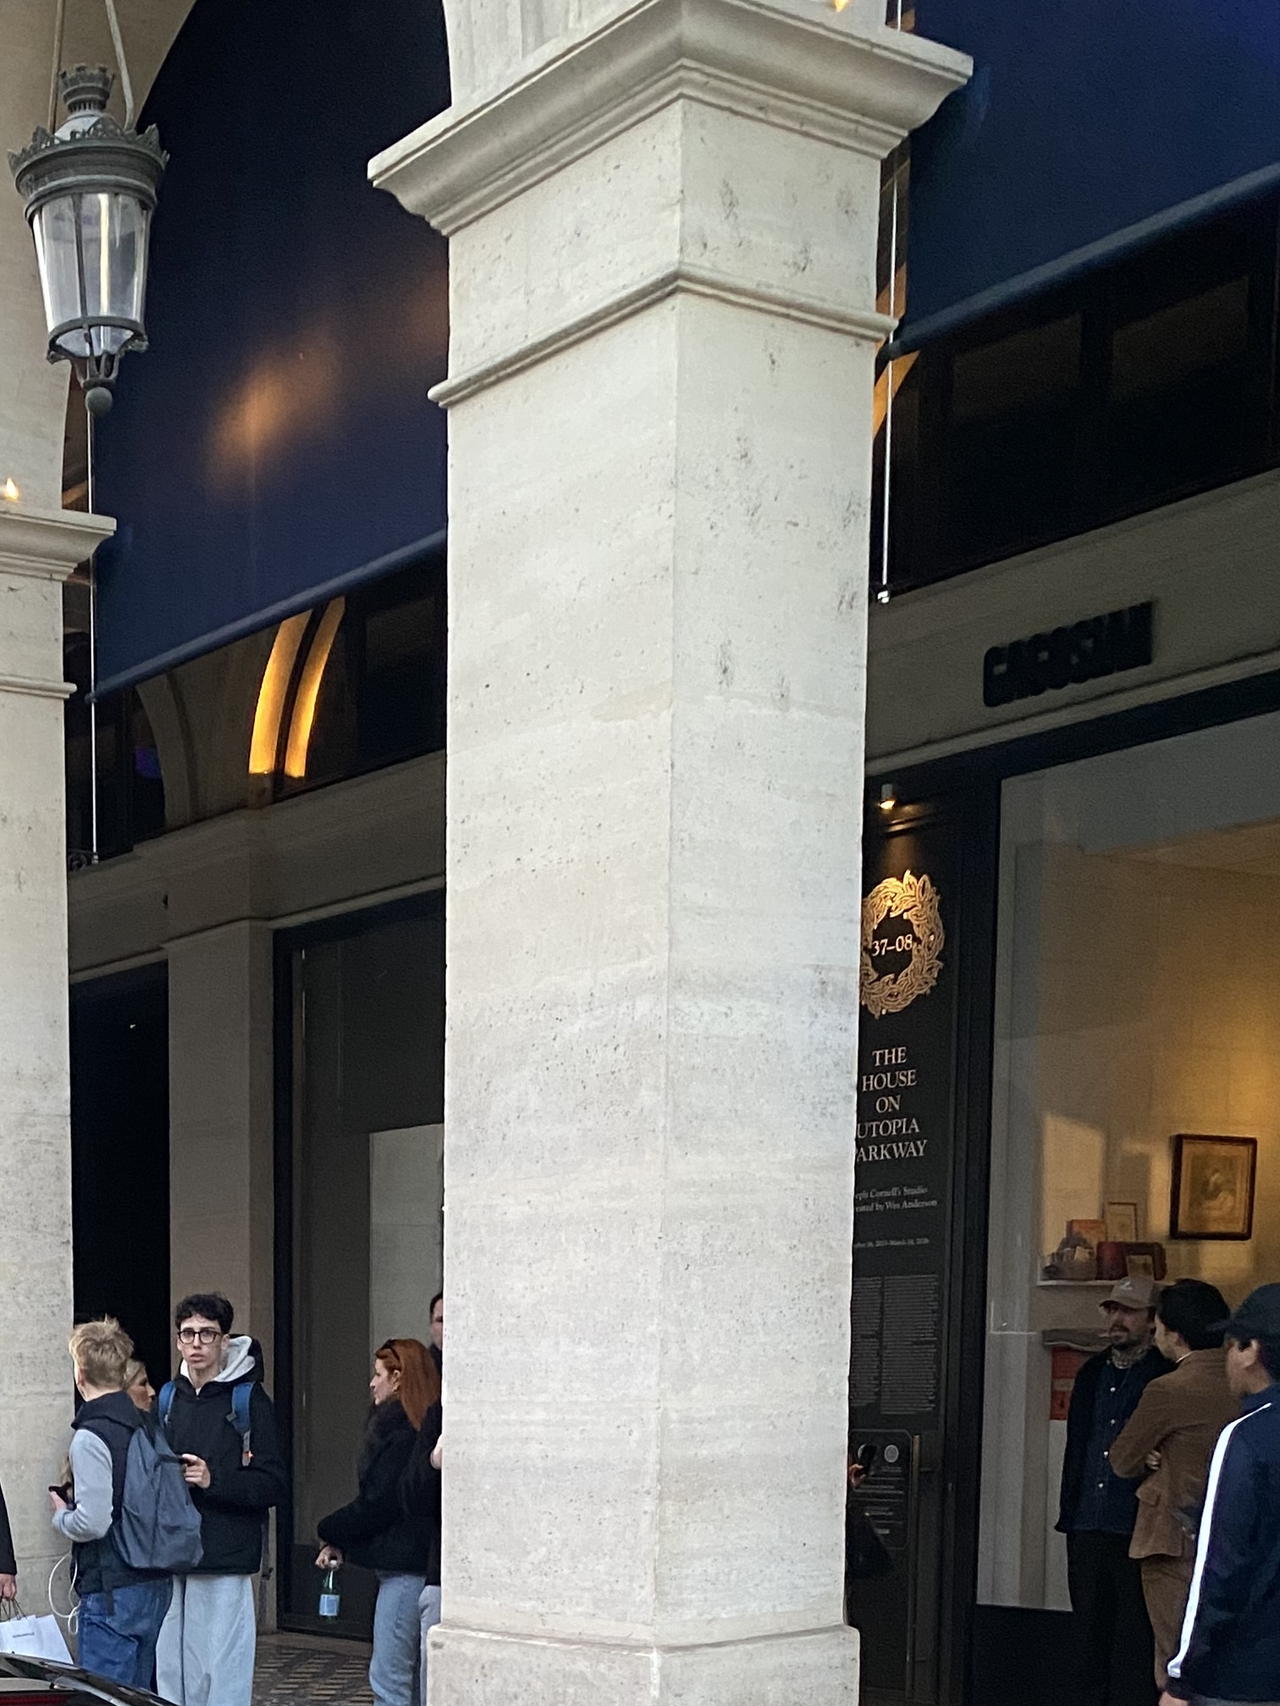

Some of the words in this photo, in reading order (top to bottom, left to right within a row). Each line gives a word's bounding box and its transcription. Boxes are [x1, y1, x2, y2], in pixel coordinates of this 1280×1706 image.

[872, 1046, 908, 1067] THE
[862, 1069, 917, 1092] HOUSE
[875, 1095, 902, 1114] ON
[856, 1117, 920, 1139] UTOPIA
[855, 1139, 928, 1162] ARKWAY
